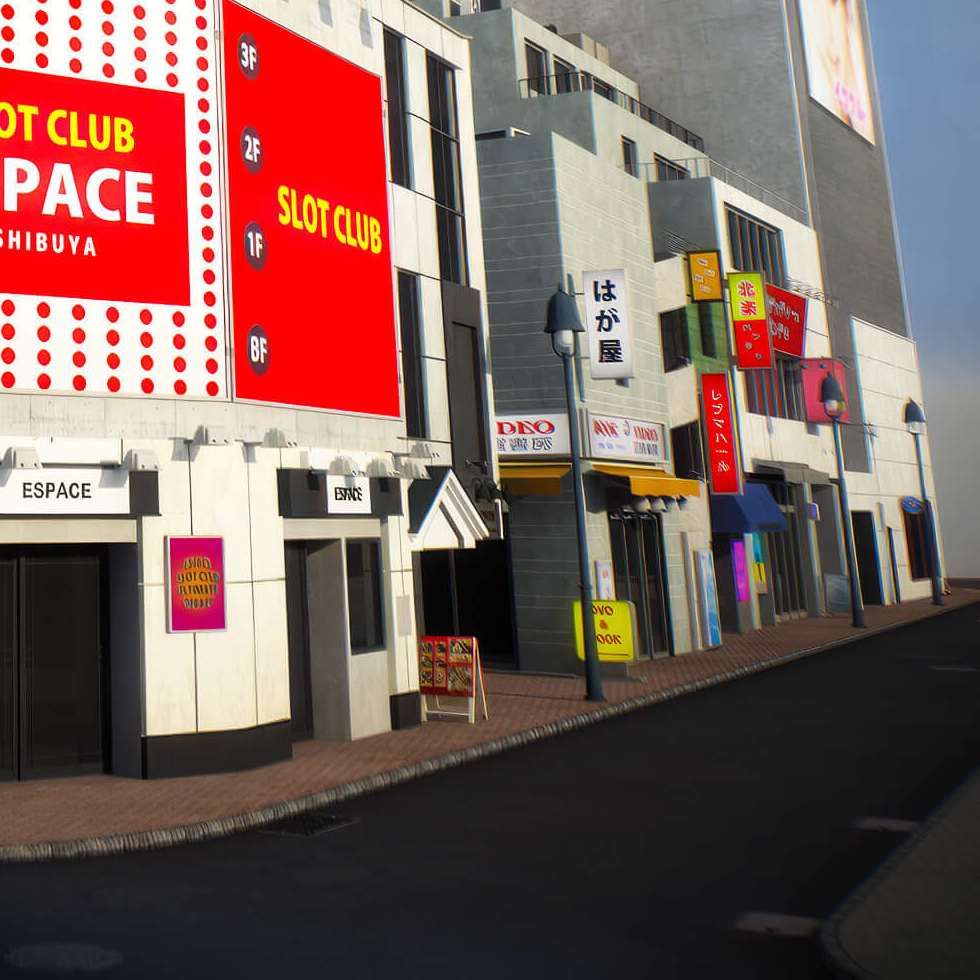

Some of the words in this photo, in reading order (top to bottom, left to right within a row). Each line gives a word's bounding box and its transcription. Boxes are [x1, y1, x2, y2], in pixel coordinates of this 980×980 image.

[240, 41, 257, 71] 3F
[46, 109, 135, 153] CLUB
[244, 134, 261, 163] 2F
[277, 185, 330, 239] SLOT
[333, 205, 383, 254] CLUB
[247, 230, 263, 258] 1F
[22, 482, 92, 499] ESPACE
